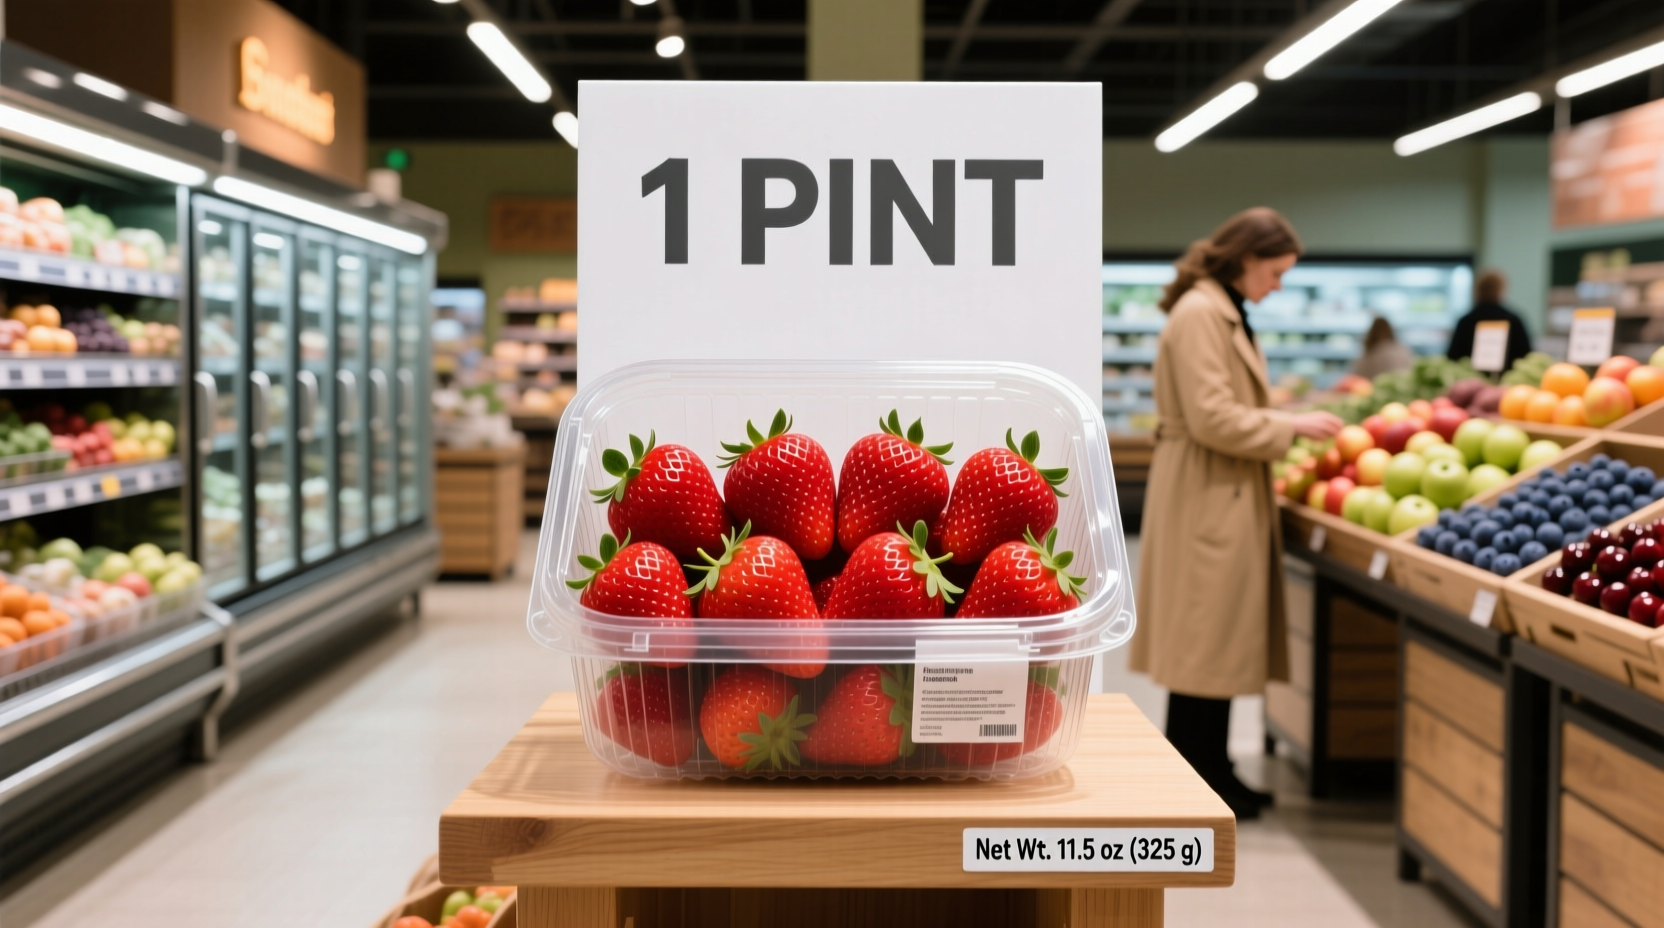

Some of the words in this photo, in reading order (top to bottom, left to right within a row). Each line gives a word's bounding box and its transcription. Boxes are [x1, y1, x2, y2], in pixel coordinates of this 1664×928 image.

[641, 157, 689, 265] 1
[741, 158, 1044, 266] PINT
[976, 837, 1012, 861] Net
[1016, 837, 1052, 861] Wt.
[1057, 837, 1095, 861] 11.5
[1100, 843, 1124, 861] oz
[1129, 836, 1176, 865] (325
[1181, 836, 1202, 866] g)
